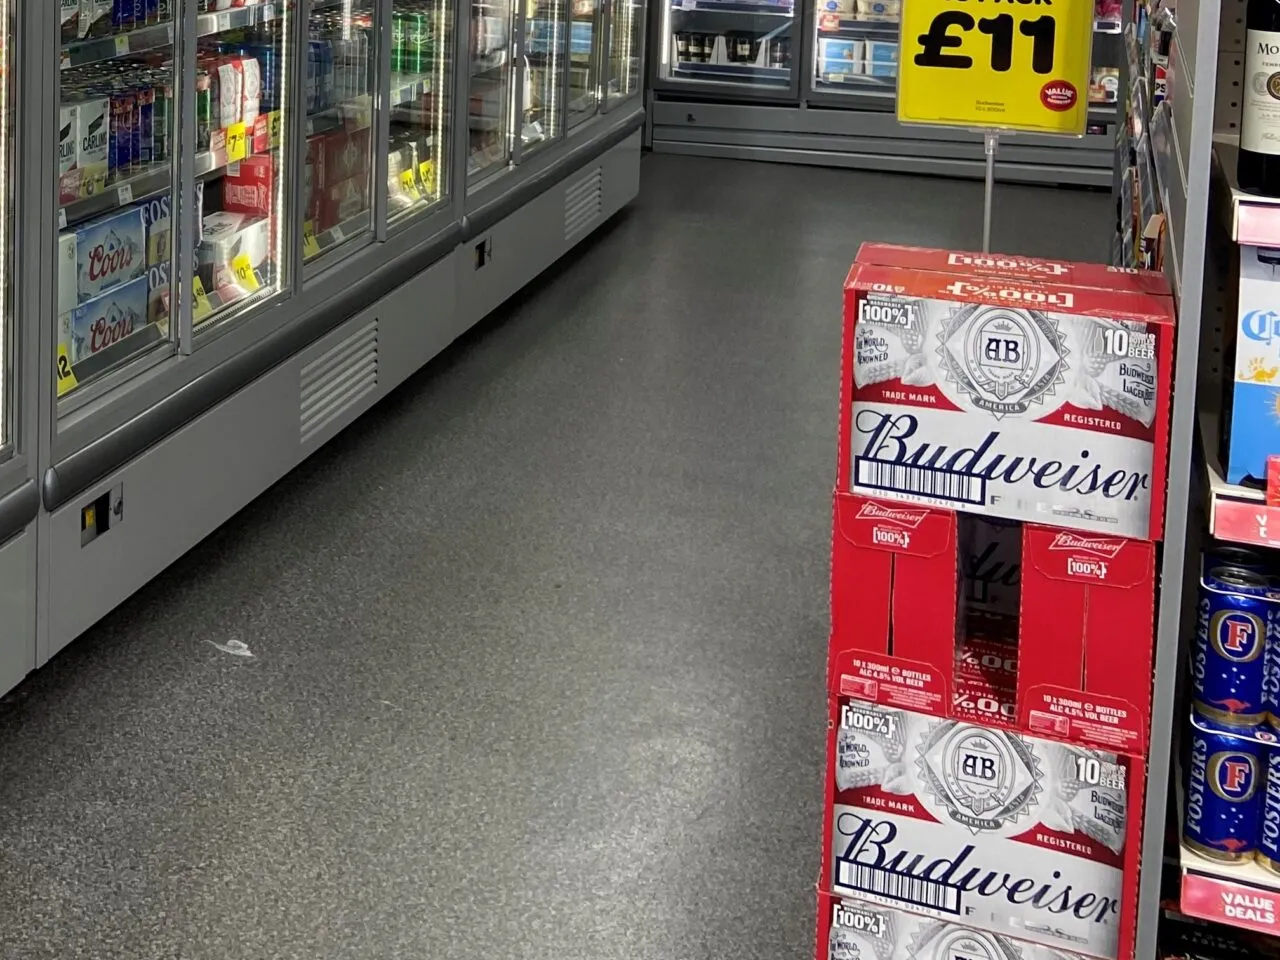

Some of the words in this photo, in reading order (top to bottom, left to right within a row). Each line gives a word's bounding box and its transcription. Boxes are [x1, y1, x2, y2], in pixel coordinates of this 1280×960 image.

[914, 10, 1056, 74] £11
[1045, 88, 1073, 98] VALUE
[88, 244, 133, 282] Coors
[90, 315, 134, 354] Coors
[1105, 329, 1128, 356] 10
[1128, 347, 1155, 359] BEER
[882, 390, 906, 401] TRADE
[909, 393, 936, 403] MARK
[978, 401, 1020, 412] AMERICA
[1064, 413, 1122, 430] REGISTERED
[856, 409, 1149, 501] Budweiser
[862, 503, 921, 521] Budweiser
[1055, 533, 1121, 553] Budweiser
[1226, 619, 1252, 652] F
[859, 668, 873, 677] ALC
[906, 678, 924, 688] BEER
[901, 669, 932, 682] BOTTLES
[1050, 703, 1063, 713] ALC
[1084, 710, 1099, 720] VOL
[1100, 713, 1119, 724] BEER
[1095, 705, 1127, 718] BOTTLES
[1076, 757, 1099, 785] 10
[1224, 760, 1249, 793] F
[1099, 776, 1125, 790] BEER
[862, 795, 886, 807] TRADE
[888, 800, 915, 813] MARK
[954, 814, 996, 828] AMERICA
[1036, 833, 1092, 855] REGISTERED
[837, 811, 1120, 924] Budweiser
[1220, 890, 1274, 911] VALUE
[1224, 906, 1275, 925] DEALS
